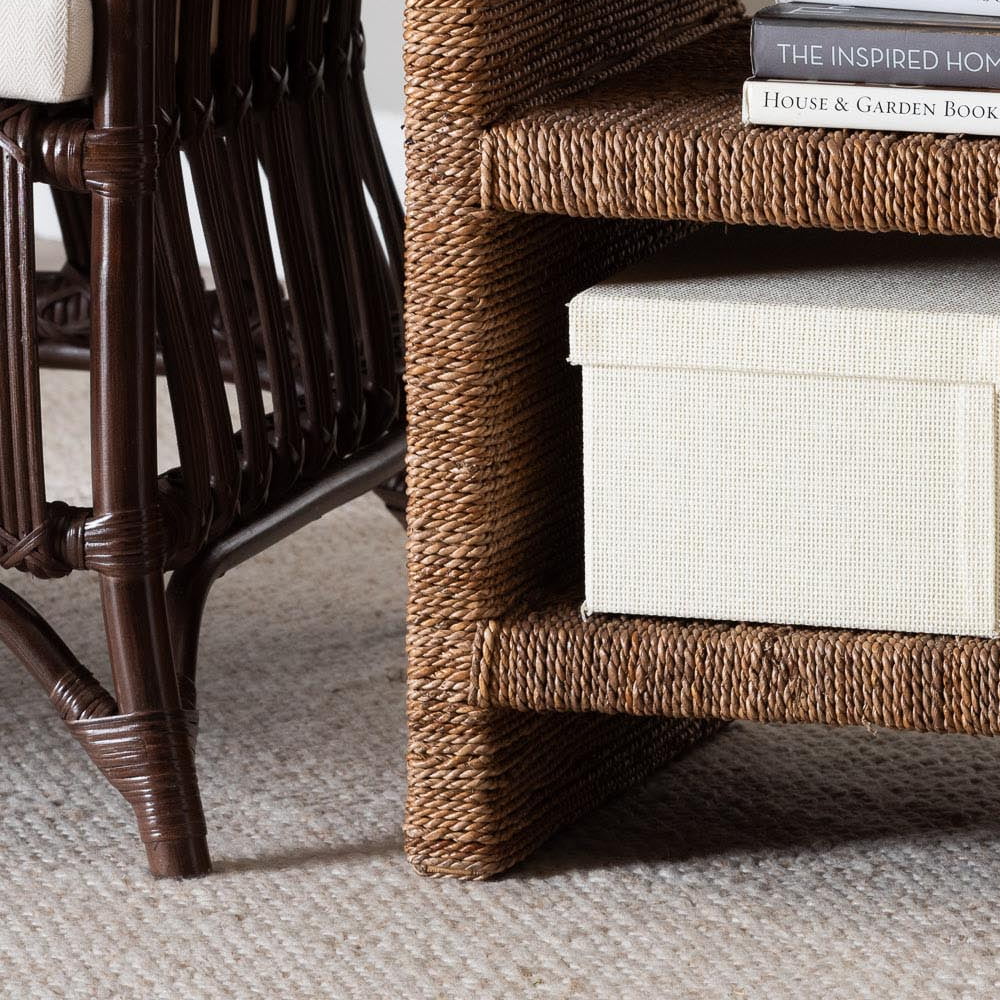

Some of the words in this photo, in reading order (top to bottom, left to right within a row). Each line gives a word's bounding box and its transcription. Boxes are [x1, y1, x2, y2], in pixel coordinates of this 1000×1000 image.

[776, 43, 824, 66] THE
[832, 46, 939, 71] INSPIRED
[763, 91, 829, 111] HOUSE
[834, 96, 849, 112] &
[856, 95, 937, 117] GARDEN
[943, 100, 999, 120] BOOK
